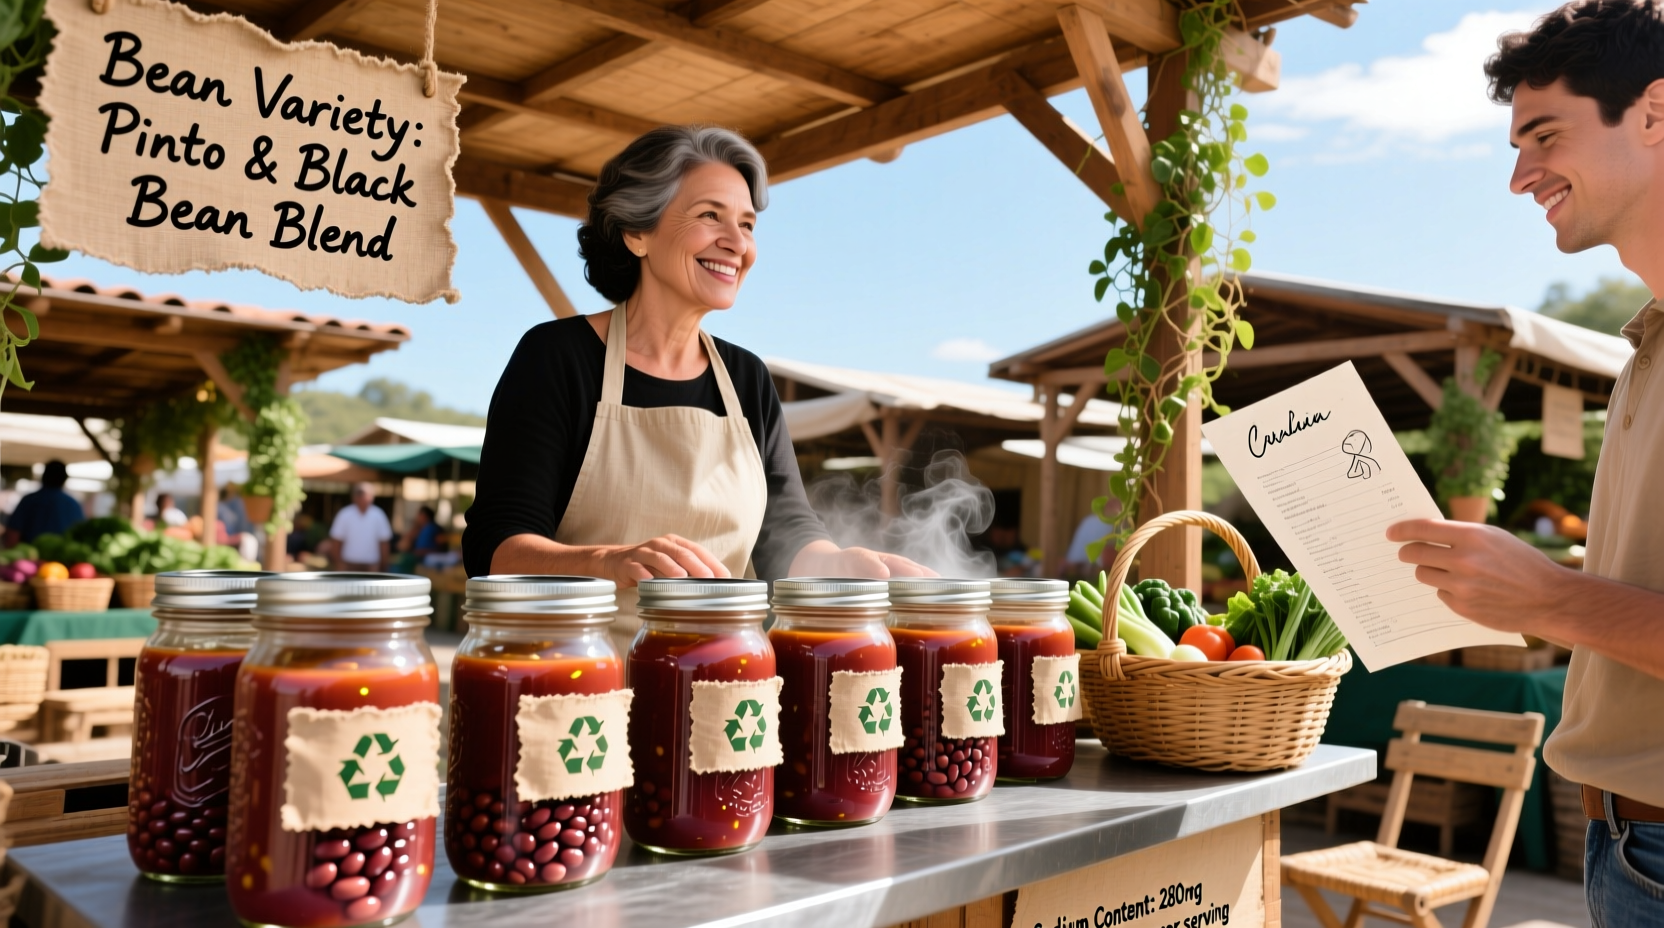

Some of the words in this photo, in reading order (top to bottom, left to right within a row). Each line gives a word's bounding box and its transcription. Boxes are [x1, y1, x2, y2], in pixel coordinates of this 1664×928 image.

[99, 31, 232, 107] Bean
[254, 66, 424, 161] Variety:
[98, 102, 226, 170] Pinto
[245, 135, 278, 184] &
[294, 143, 417, 207] Black
[126, 175, 253, 238] Bean
[269, 201, 397, 261] Blend
[1093, 895, 1156, 928] Content:
[1184, 902, 1230, 928] serving
